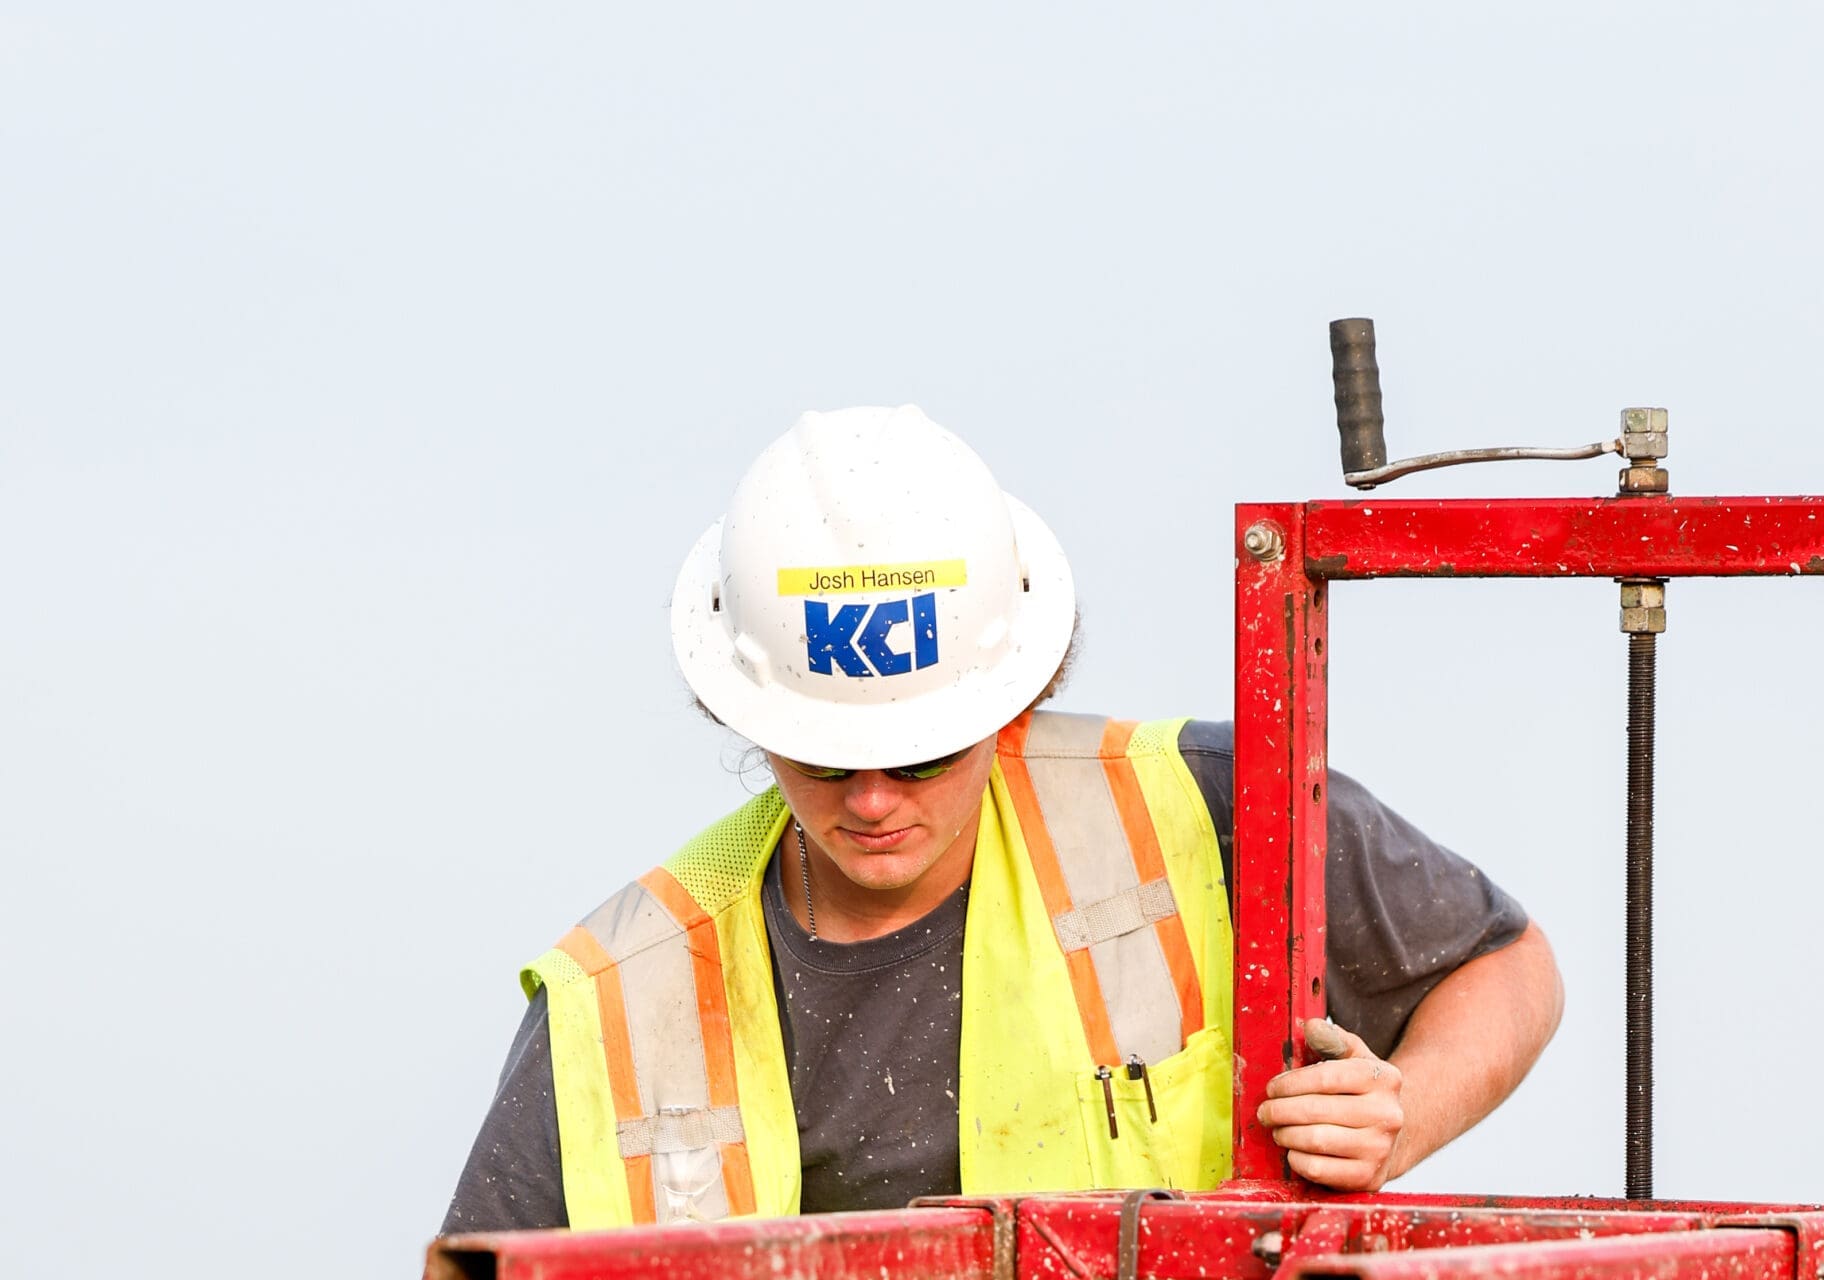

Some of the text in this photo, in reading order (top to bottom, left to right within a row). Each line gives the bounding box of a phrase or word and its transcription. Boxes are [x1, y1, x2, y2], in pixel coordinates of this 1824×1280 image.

[809, 567, 935, 590] Josh Hansen
[804, 593, 938, 677] KCI
